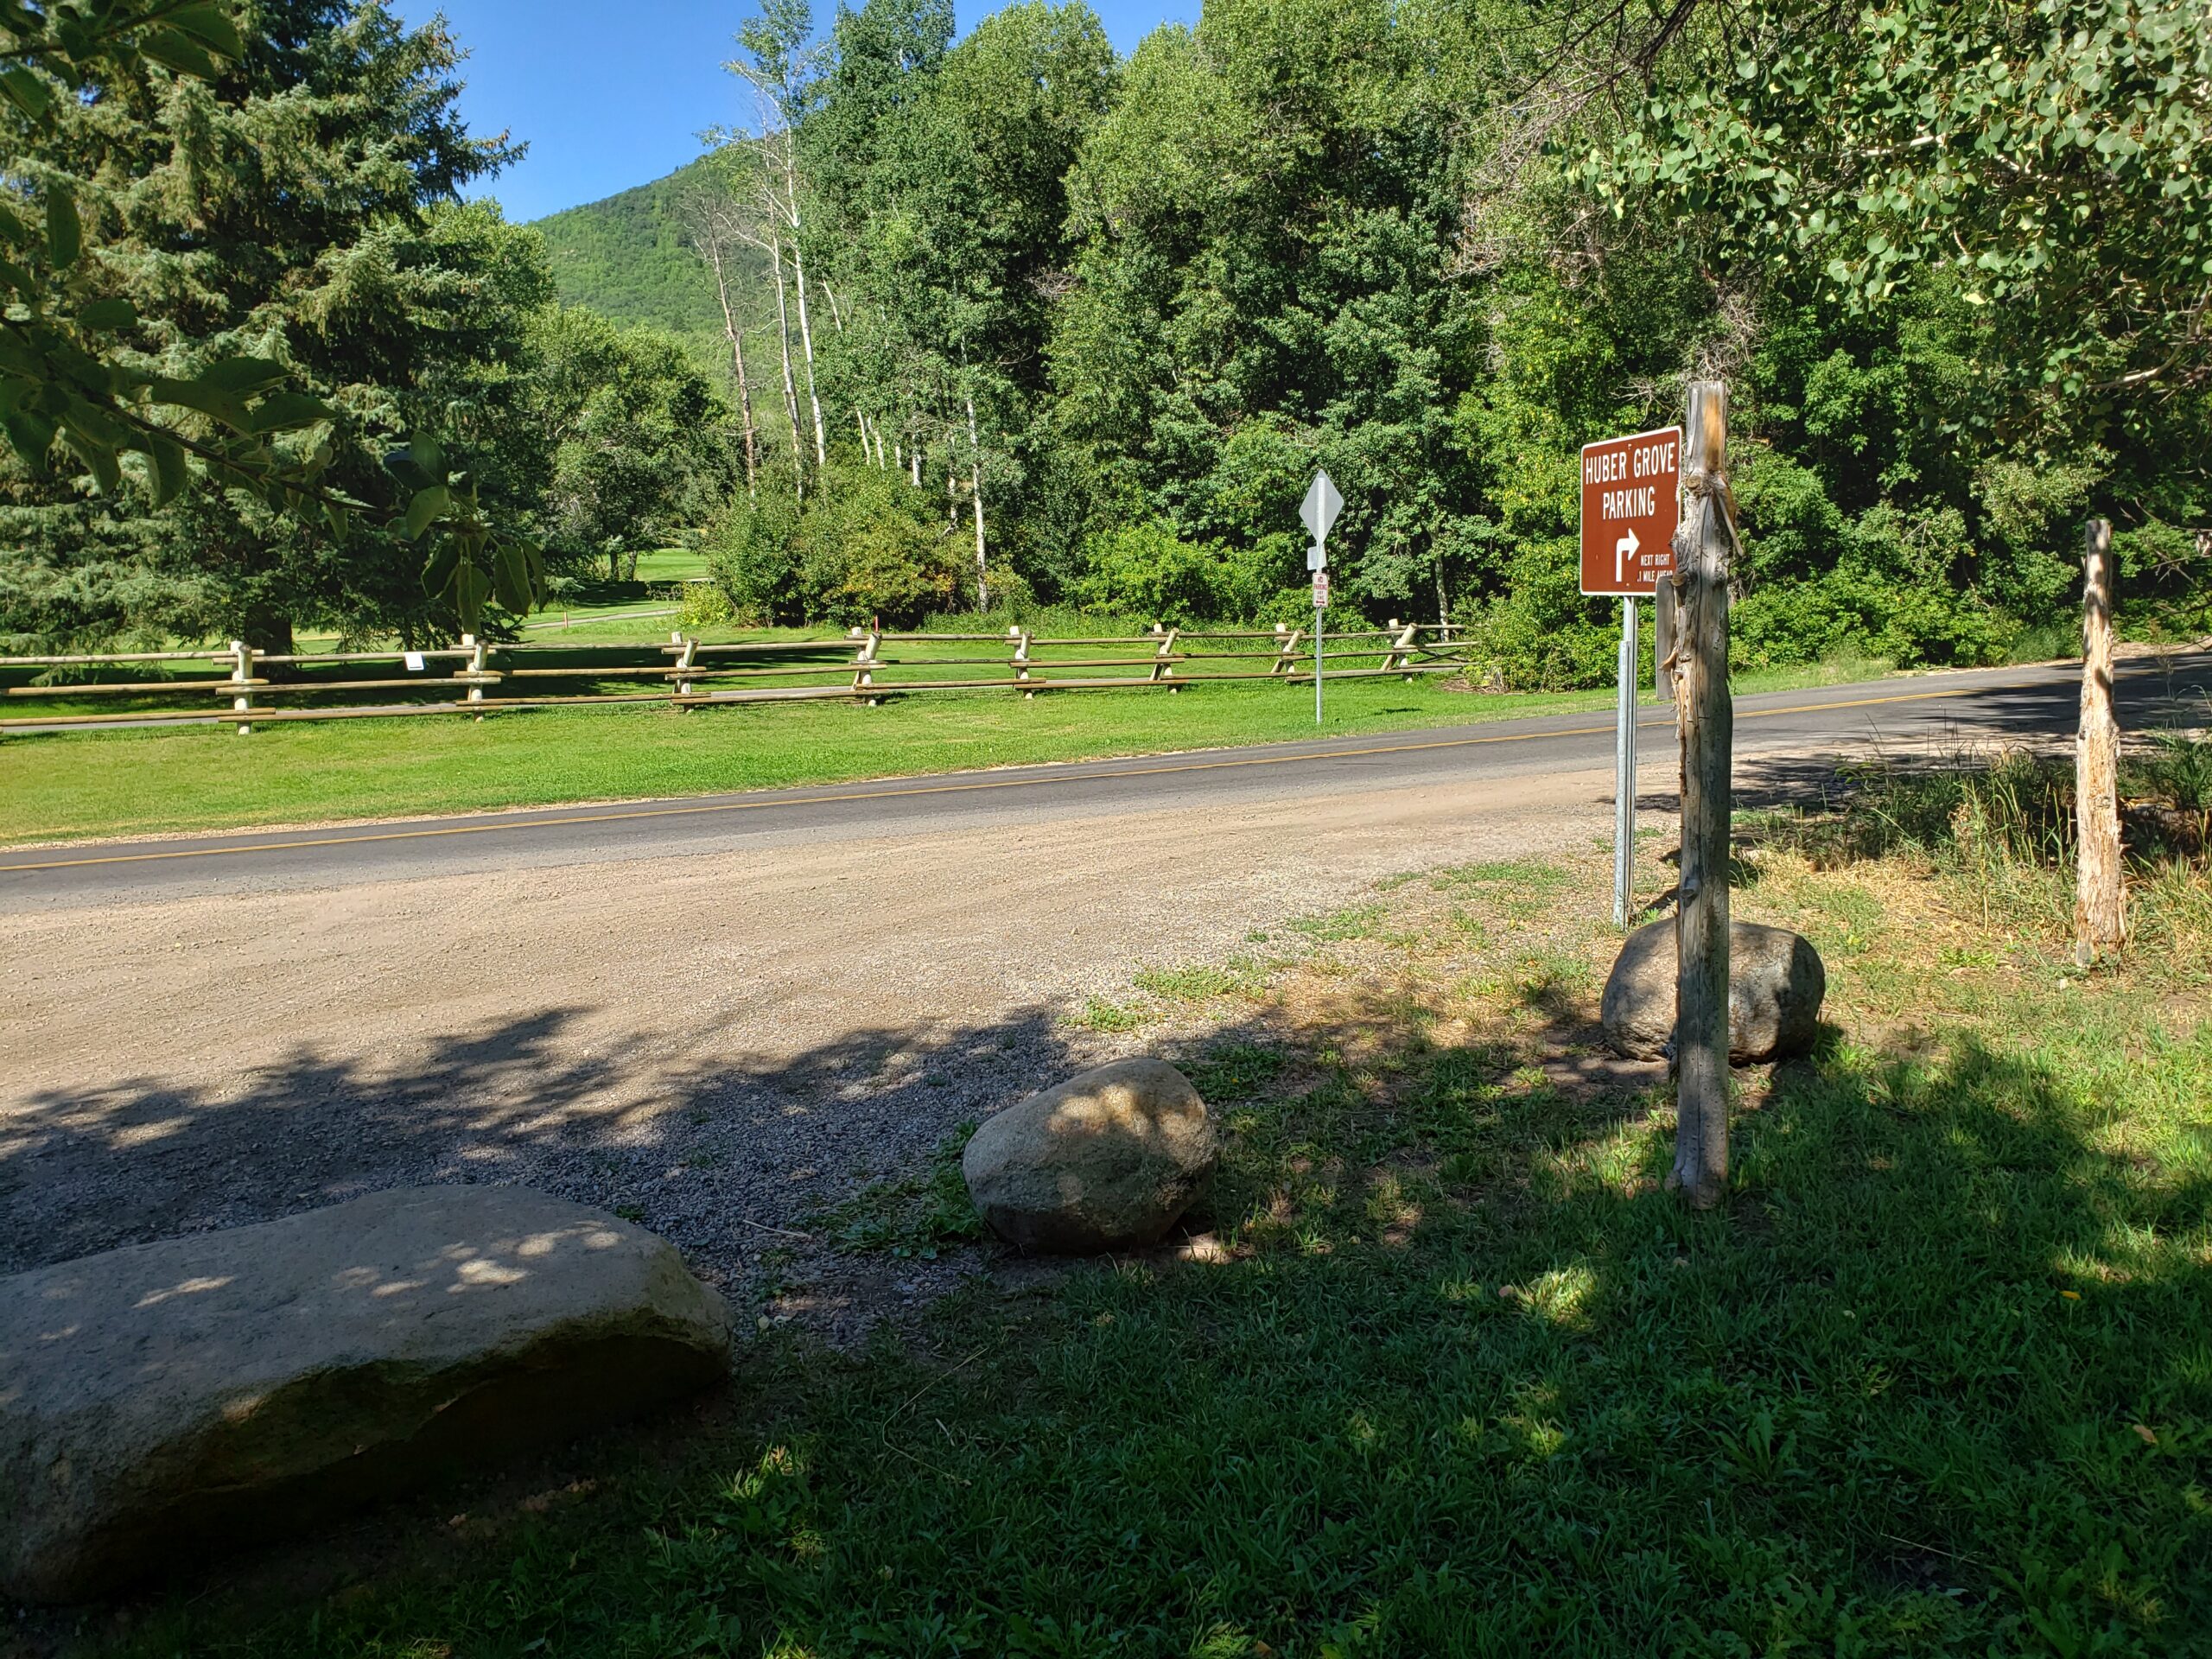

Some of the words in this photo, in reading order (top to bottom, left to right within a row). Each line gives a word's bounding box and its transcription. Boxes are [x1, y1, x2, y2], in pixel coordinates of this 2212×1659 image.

[1586, 451, 1627, 485] HUBER
[1633, 442, 1675, 479] GROVE
[1603, 486, 1656, 520] PARKING
[1640, 554, 1654, 567] NEXT
[1655, 553, 1670, 566] RIGHT
[1643, 570, 1656, 582] MILE
